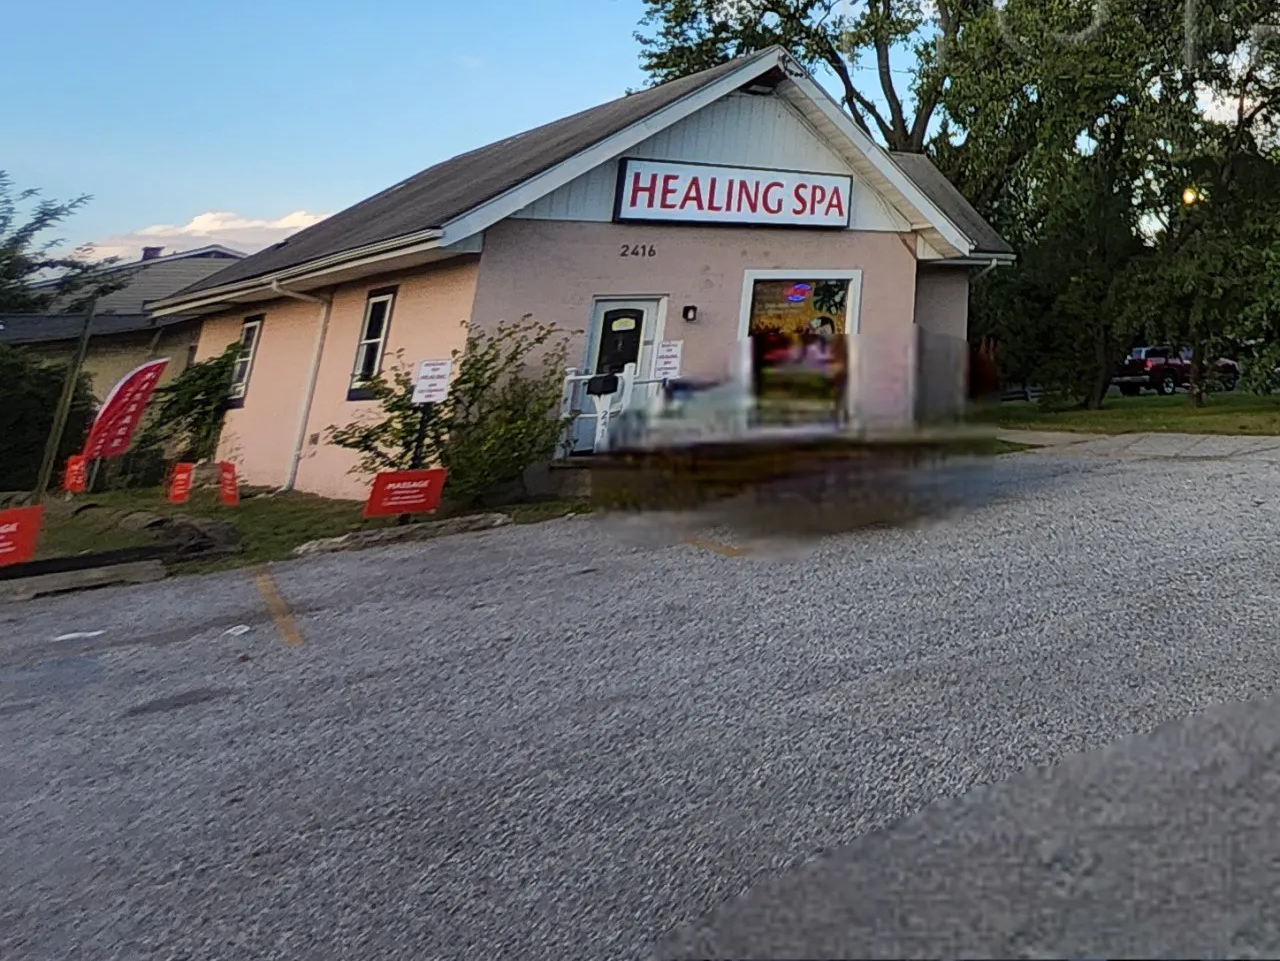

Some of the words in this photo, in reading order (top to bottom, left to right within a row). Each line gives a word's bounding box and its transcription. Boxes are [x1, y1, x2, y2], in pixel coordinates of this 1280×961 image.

[629, 171, 785, 215] HEALING
[791, 182, 845, 217] SPA
[619, 244, 657, 257] 2416
